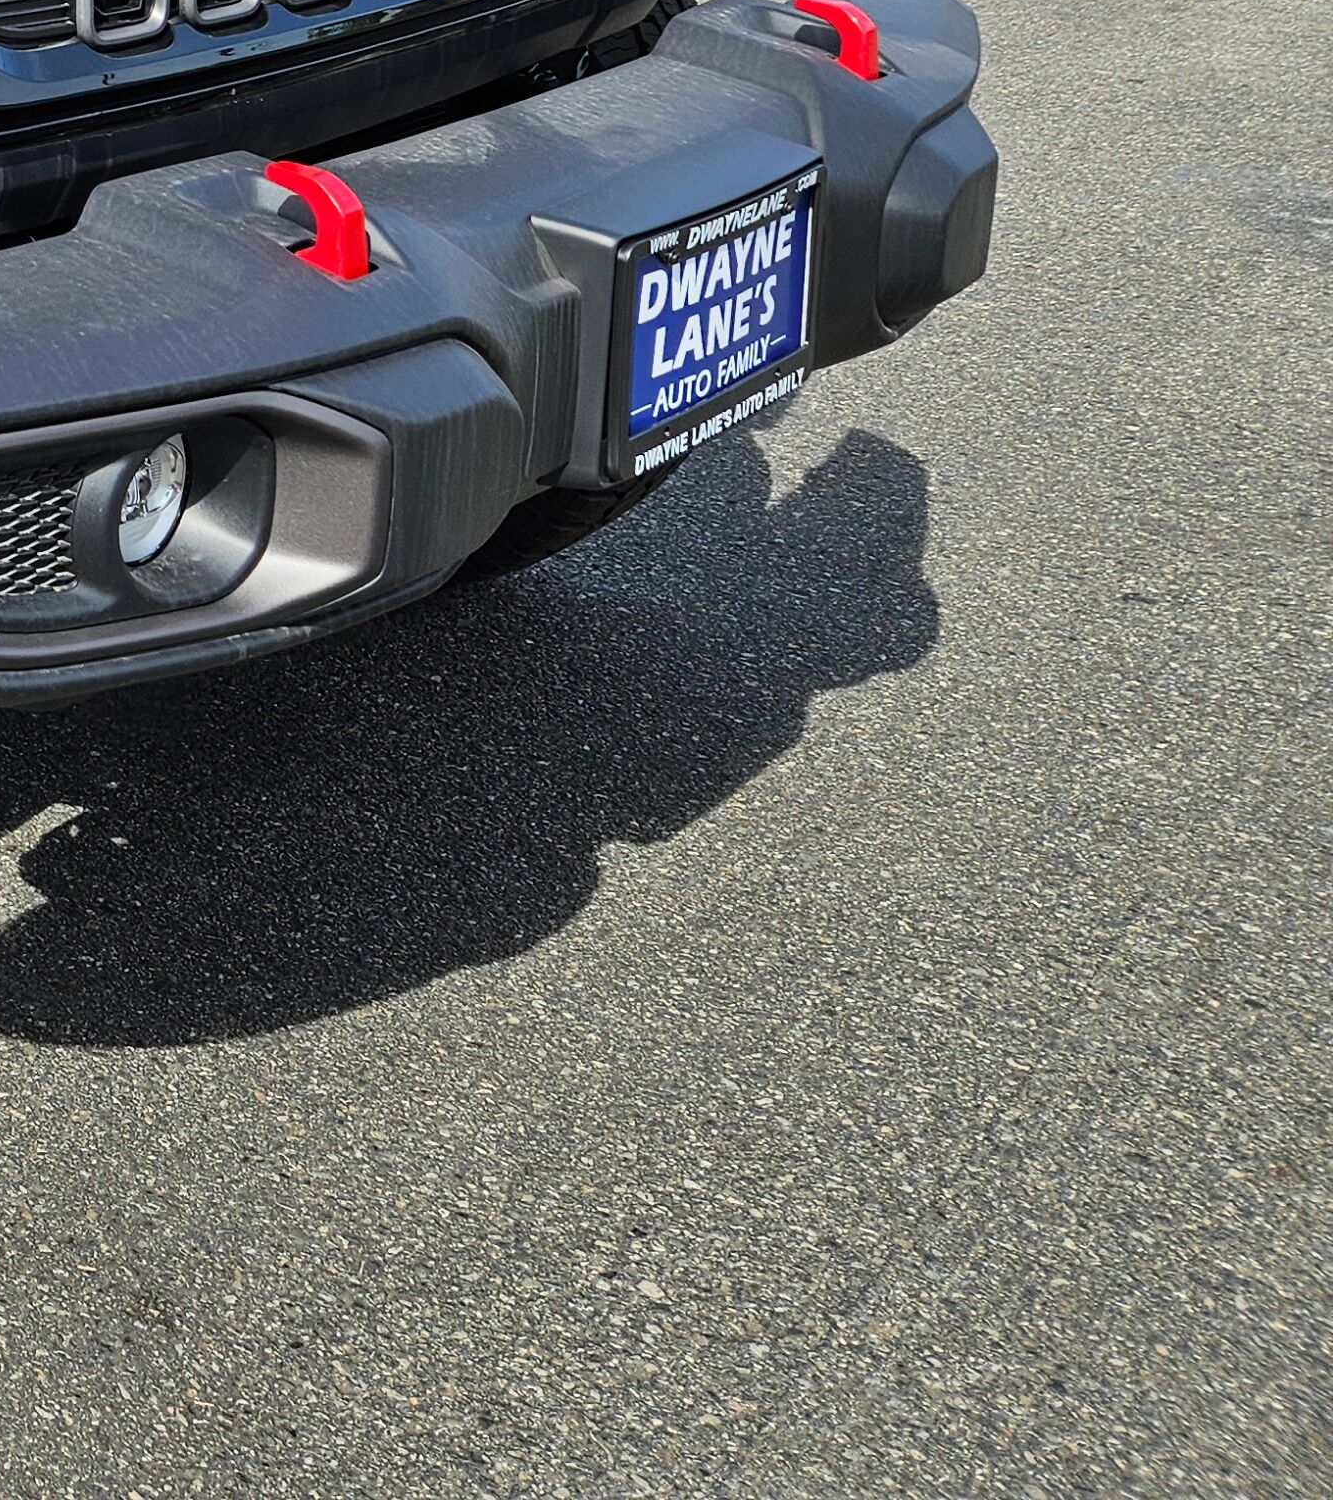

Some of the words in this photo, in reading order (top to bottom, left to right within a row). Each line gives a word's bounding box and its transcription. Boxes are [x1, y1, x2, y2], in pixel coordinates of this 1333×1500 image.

[638, 210, 796, 324] DWAYNE
[651, 274, 777, 378] LANE'S
[653, 368, 712, 417] AUTO
[717, 334, 771, 388] FAMILY
[634, 431, 689, 476] DWAYNE
[691, 408, 732, 446] LANE'S
[734, 392, 763, 423] AUTO
[764, 367, 805, 406] FAMILY
